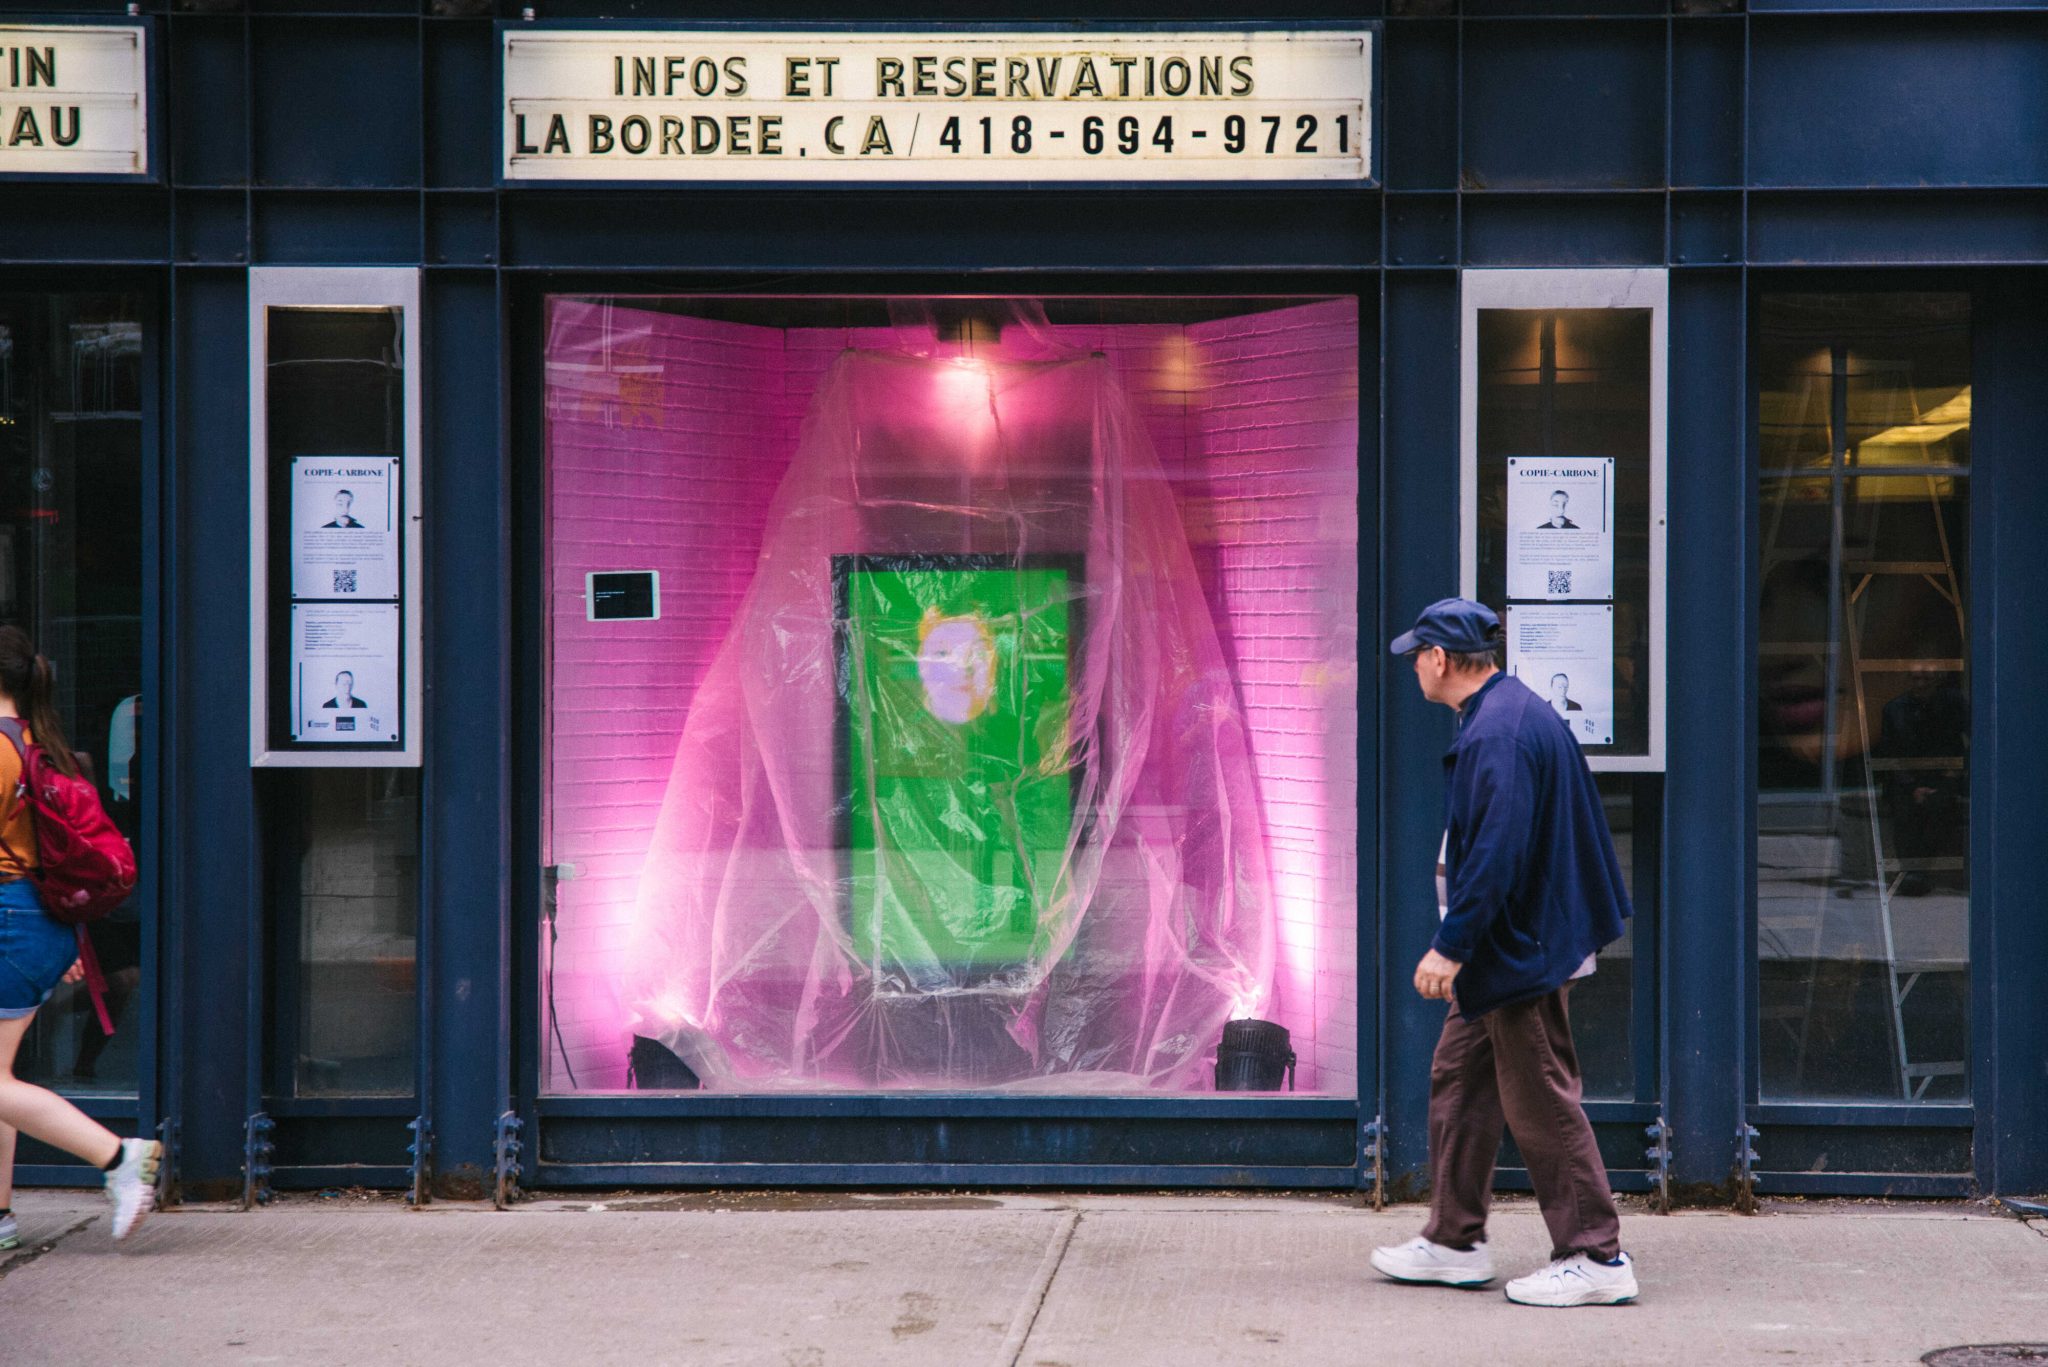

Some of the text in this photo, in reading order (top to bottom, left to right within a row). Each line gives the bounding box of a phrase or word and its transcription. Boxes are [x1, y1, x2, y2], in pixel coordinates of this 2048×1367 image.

[0, 46, 56, 88] IN
[613, 55, 1253, 98] INFOS ET RESERVATIONS
[0, 105, 81, 147] AU
[304, 468, 384, 477] COPIE-CARBONE
[1519, 468, 1599, 478] COPIE-CARBONE
